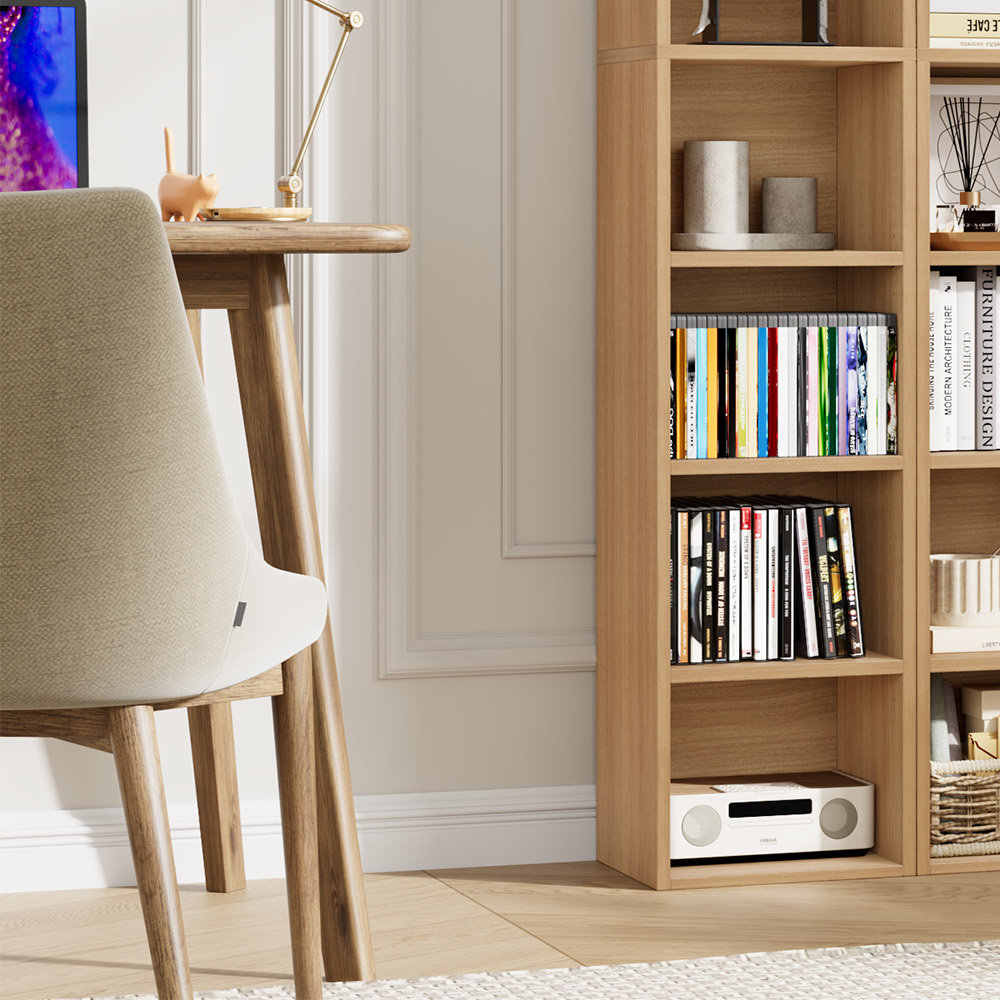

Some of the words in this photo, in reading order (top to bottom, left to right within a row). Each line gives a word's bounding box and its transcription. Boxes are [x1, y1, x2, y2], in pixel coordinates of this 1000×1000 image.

[944, 305, 952, 374] ARCHITECTURE
[982, 268, 993, 375] FURNITURE
[963, 332, 971, 388] CLOTHING
[944, 377, 952, 416] MODERN
[982, 381, 993, 447] DESIGN
